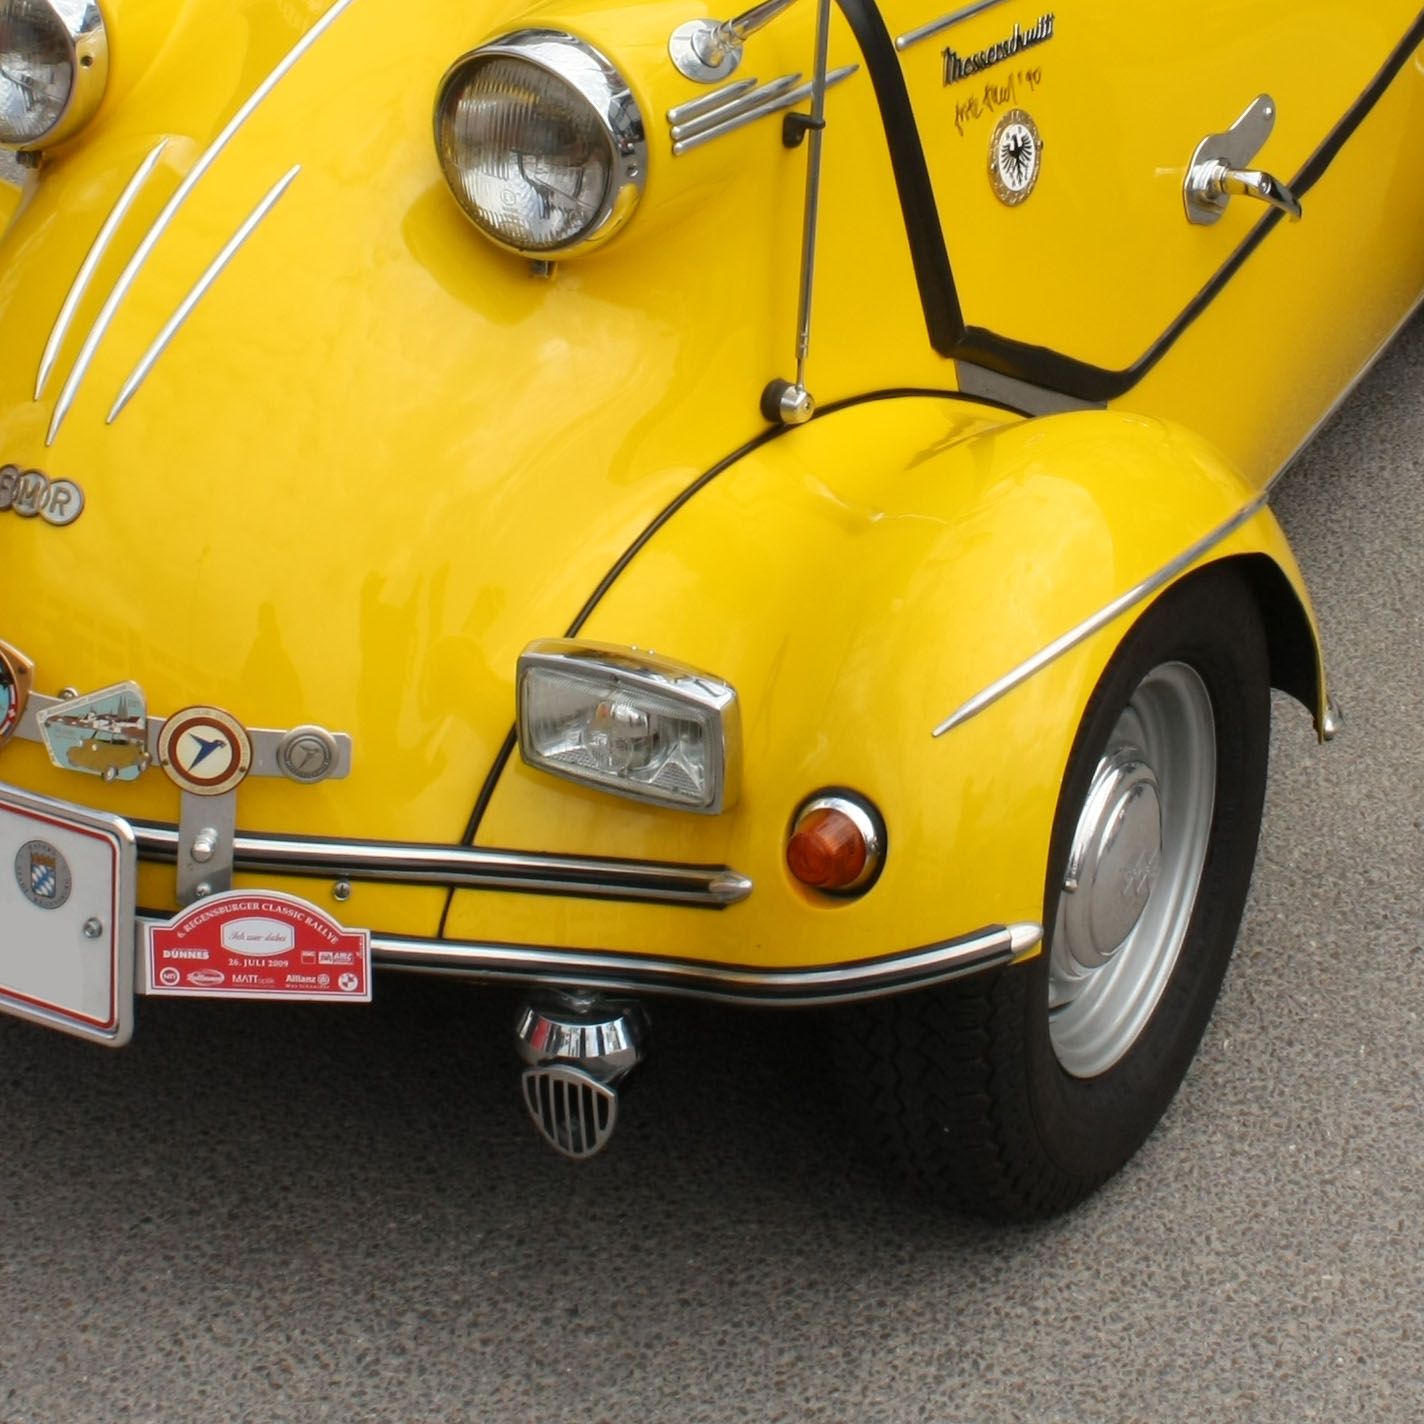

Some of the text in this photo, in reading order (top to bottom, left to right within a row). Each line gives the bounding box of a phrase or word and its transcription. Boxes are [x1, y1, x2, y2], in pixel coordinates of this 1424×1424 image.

[183, 902, 260, 933] REGENSBURGER
[261, 903, 306, 921] CLASSIC
[304, 917, 340, 945] RALLYE
[243, 959, 266, 967] JULI
[285, 974, 317, 983] Allianz
